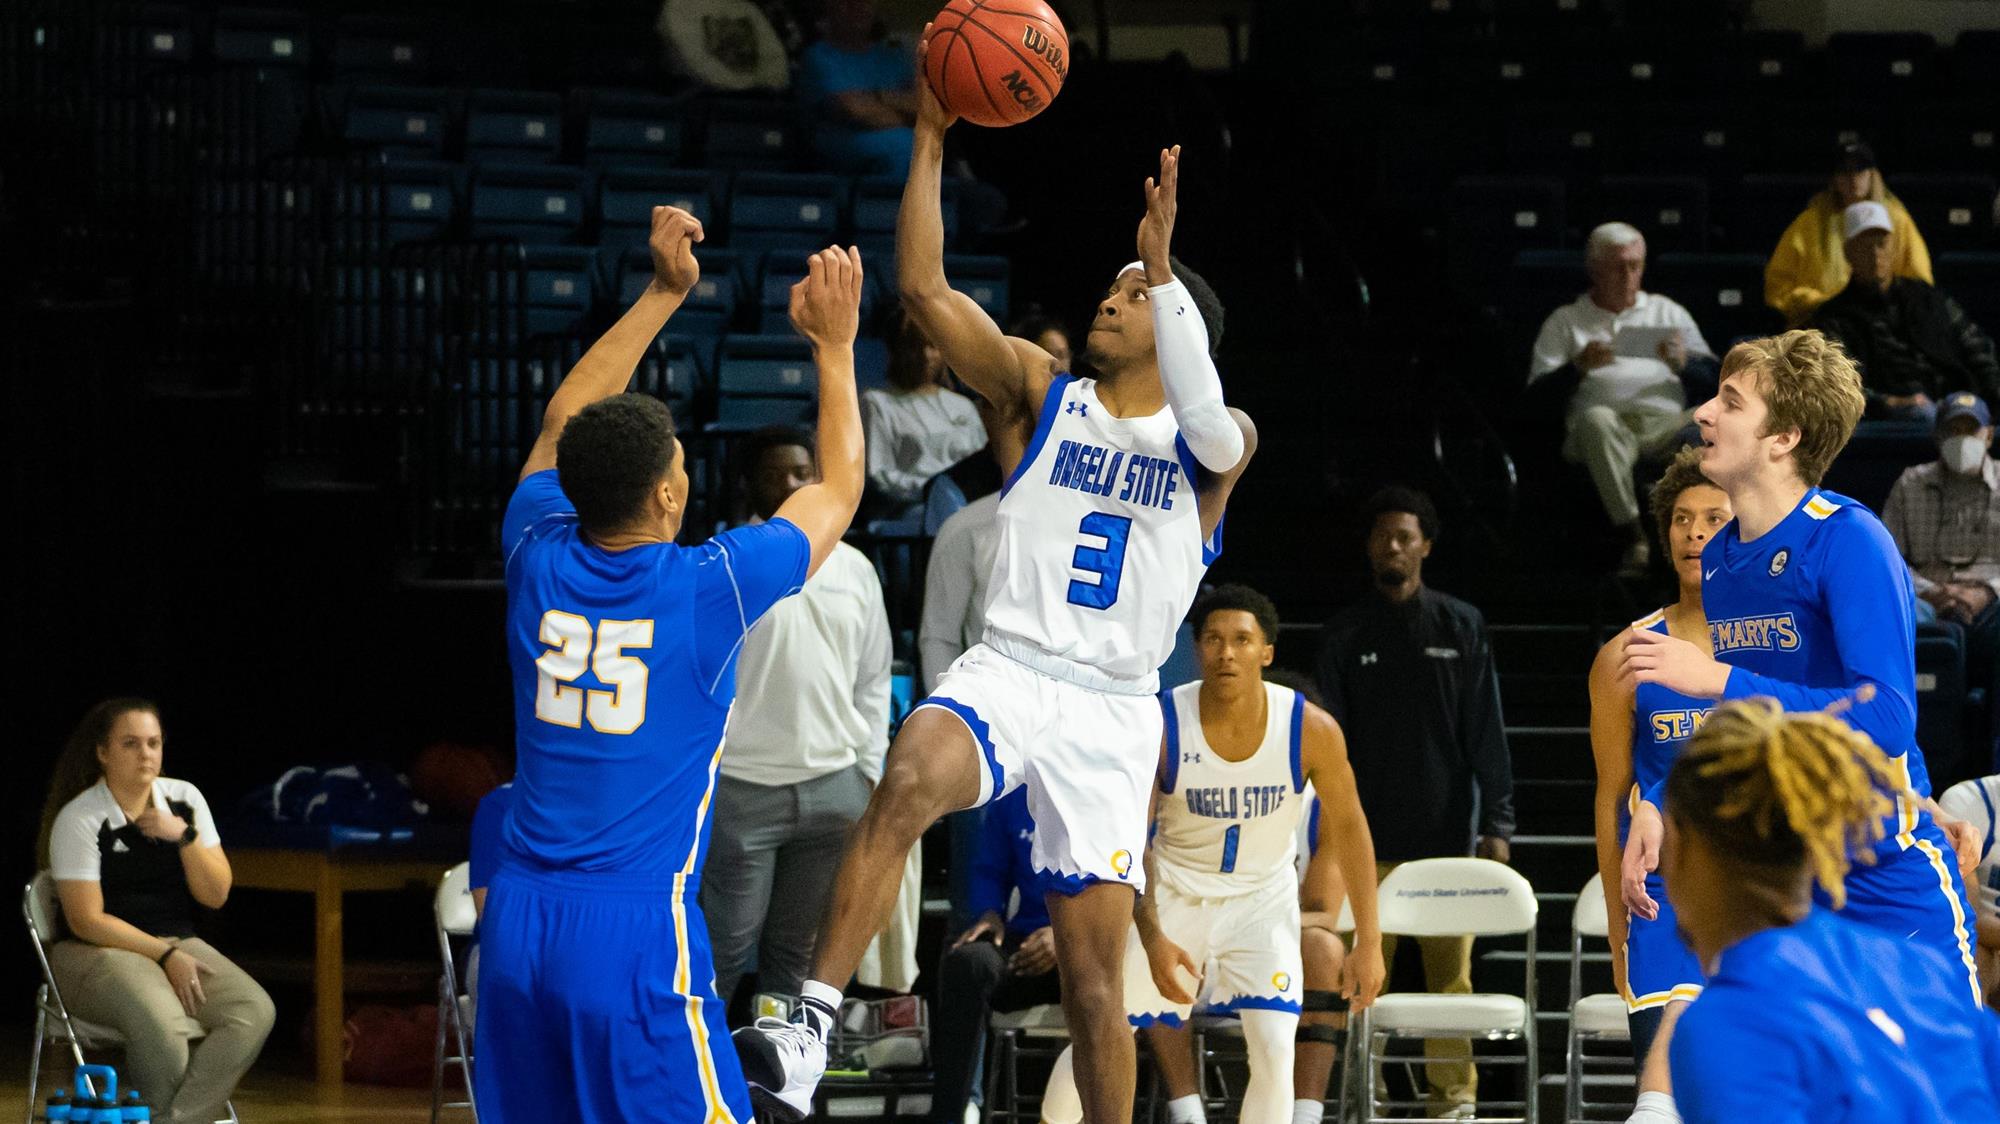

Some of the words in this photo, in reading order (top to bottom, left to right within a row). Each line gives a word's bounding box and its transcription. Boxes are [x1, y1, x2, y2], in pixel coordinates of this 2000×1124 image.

[1023, 24, 1067, 82] Wils
[1049, 440, 1124, 497] ANGELO
[1119, 454, 1178, 510] STATE
[1066, 511, 1132, 611] 3
[535, 609, 654, 735] 25
[1186, 787, 1237, 819] ANGELO
[1244, 785, 1286, 819] STATE
[1219, 824, 1241, 873] 1
[1433, 888, 1458, 897] State
[1460, 887, 1509, 896] University
